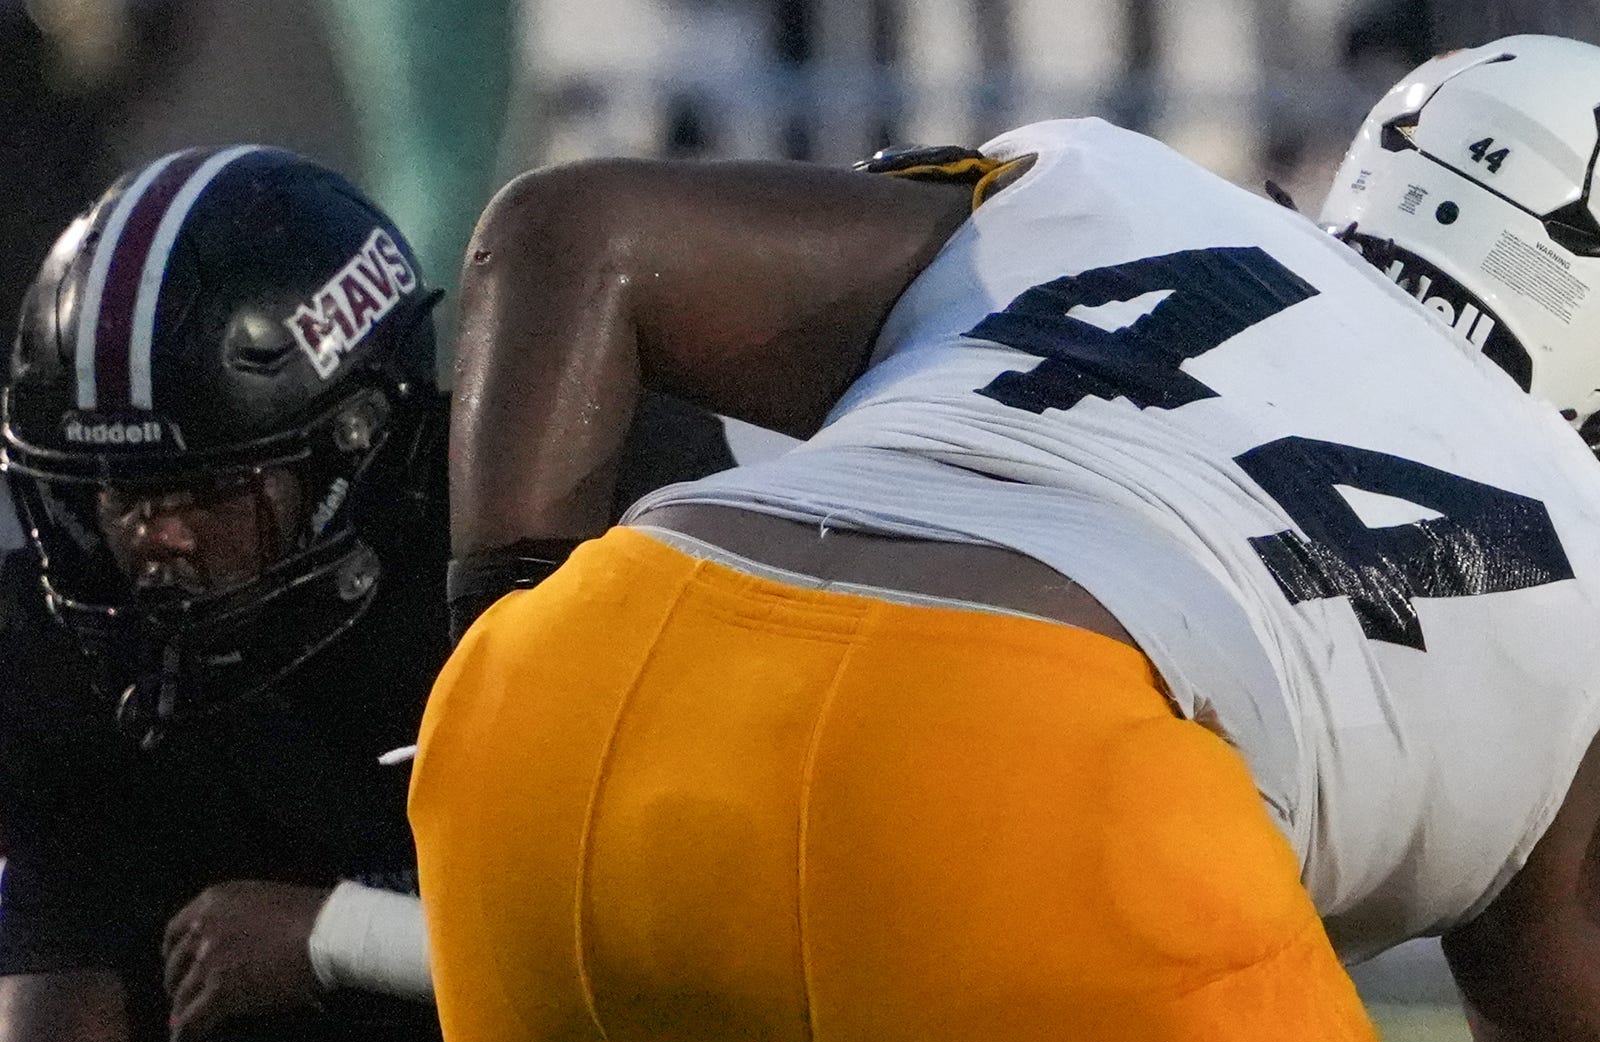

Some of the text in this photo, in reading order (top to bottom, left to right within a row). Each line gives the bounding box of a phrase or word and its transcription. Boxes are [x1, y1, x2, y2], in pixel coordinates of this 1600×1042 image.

[1469, 137, 1511, 174] 44
[1535, 240, 1572, 271] WARNING
[284, 227, 416, 379] MAVS
[66, 420, 162, 443] Riddell
